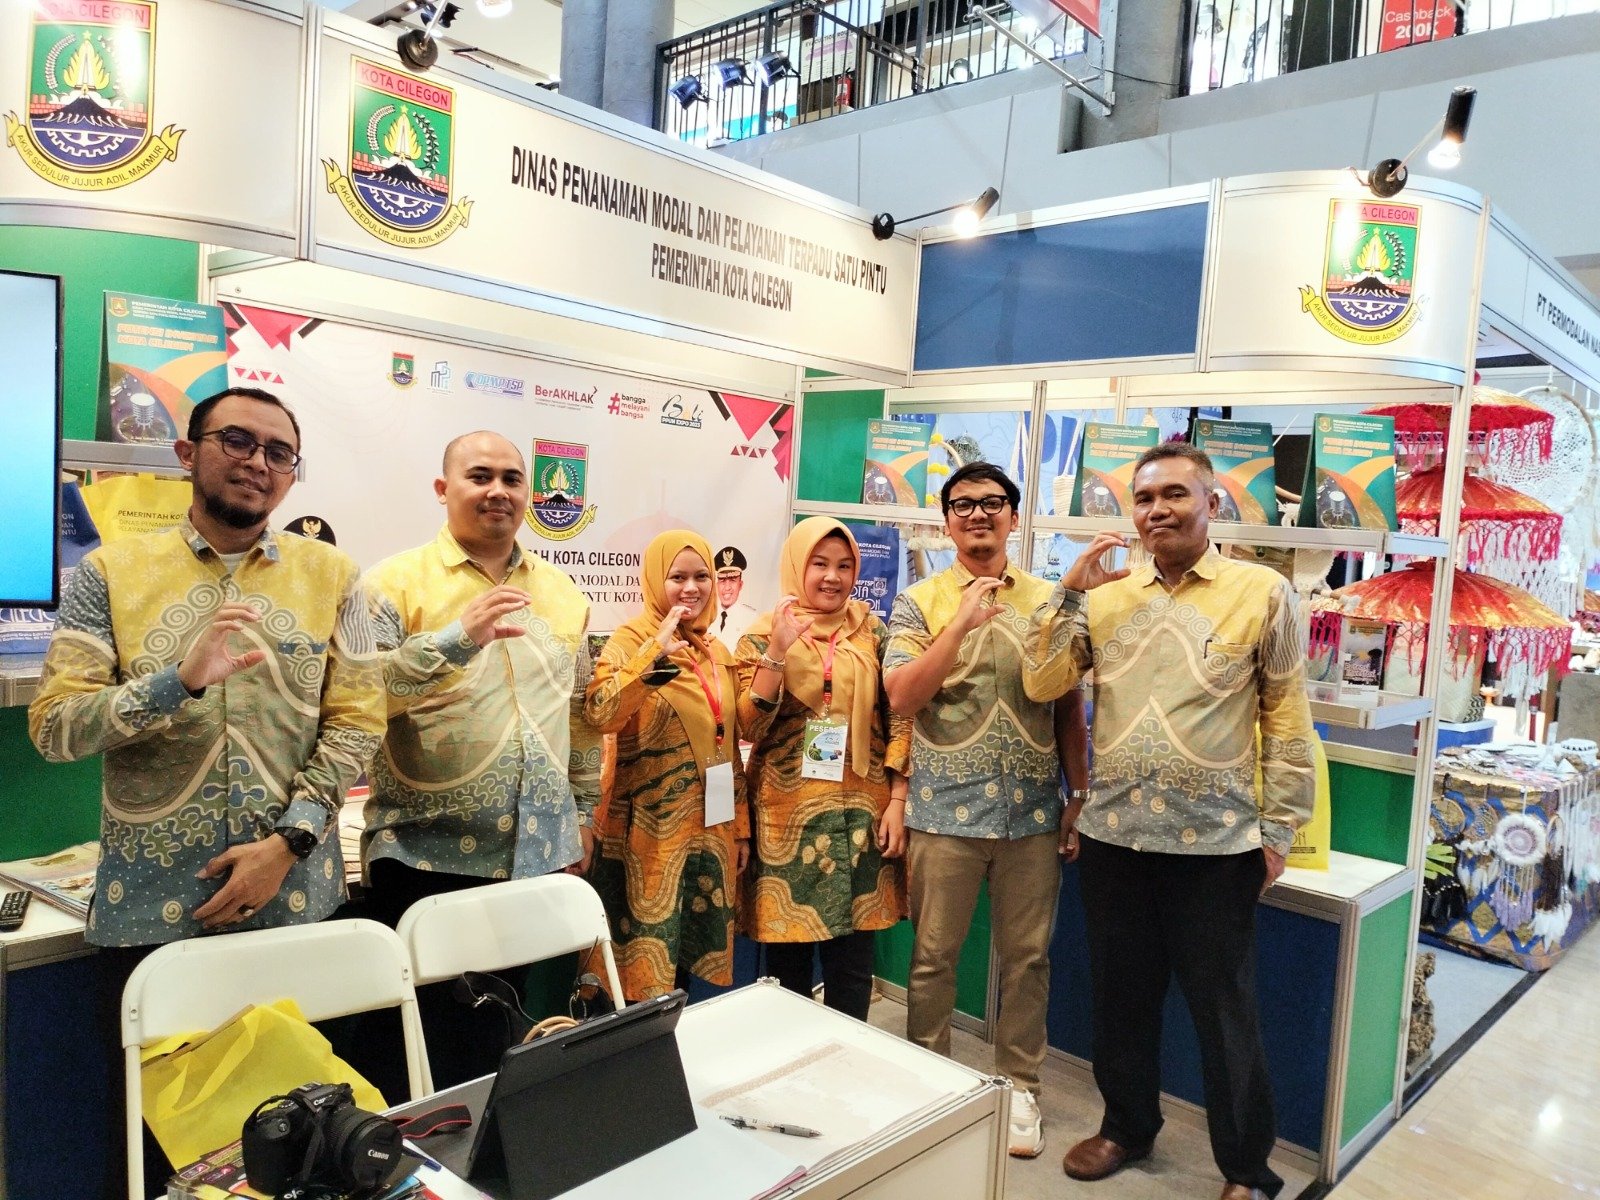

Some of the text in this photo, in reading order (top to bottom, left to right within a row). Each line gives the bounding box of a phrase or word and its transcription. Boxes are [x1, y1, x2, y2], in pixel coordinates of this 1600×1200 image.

[79, 4, 145, 23] CILEGON
[1385, 6, 1452, 23] Cashback
[1395, 22, 1440, 39] 200K
[361, 66, 448, 107] KOTA CILEGON
[17, 134, 164, 187] AKUR SEDULUR JUJUR ADIL MAKMUR
[339, 183, 460, 245] AKUR SEDULUR JUJUR ADIL MAKMUR
[512, 145, 888, 295] DINAS PENANAMAN MODAL DAN PELAYANAN TERPADU SATU PINTU
[1371, 206, 1415, 221] CILEGON
[652, 243, 793, 312] PEMERINTAH KOTA CILEGON
[1537, 292, 1547, 317] PT
[1547, 302, 1590, 351] PERMODALAN
[535, 384, 594, 404] BerAKHLAK
[621, 394, 646, 404] bangga
[621, 410, 644, 419] bangsa
[538, 444, 584, 456] KOTA CILEGON
[118, 510, 168, 519] PEMERINTAH
[554, 550, 585, 566] KOTA
[589, 552, 641, 567] CILEGON
[580, 575, 625, 587] MODAL
[626, 575, 641, 587] DA
[582, 591, 645, 602] NTU KOTA
[850, 586, 868, 598] OTA
[368, 1149, 390, 1160] Canon
